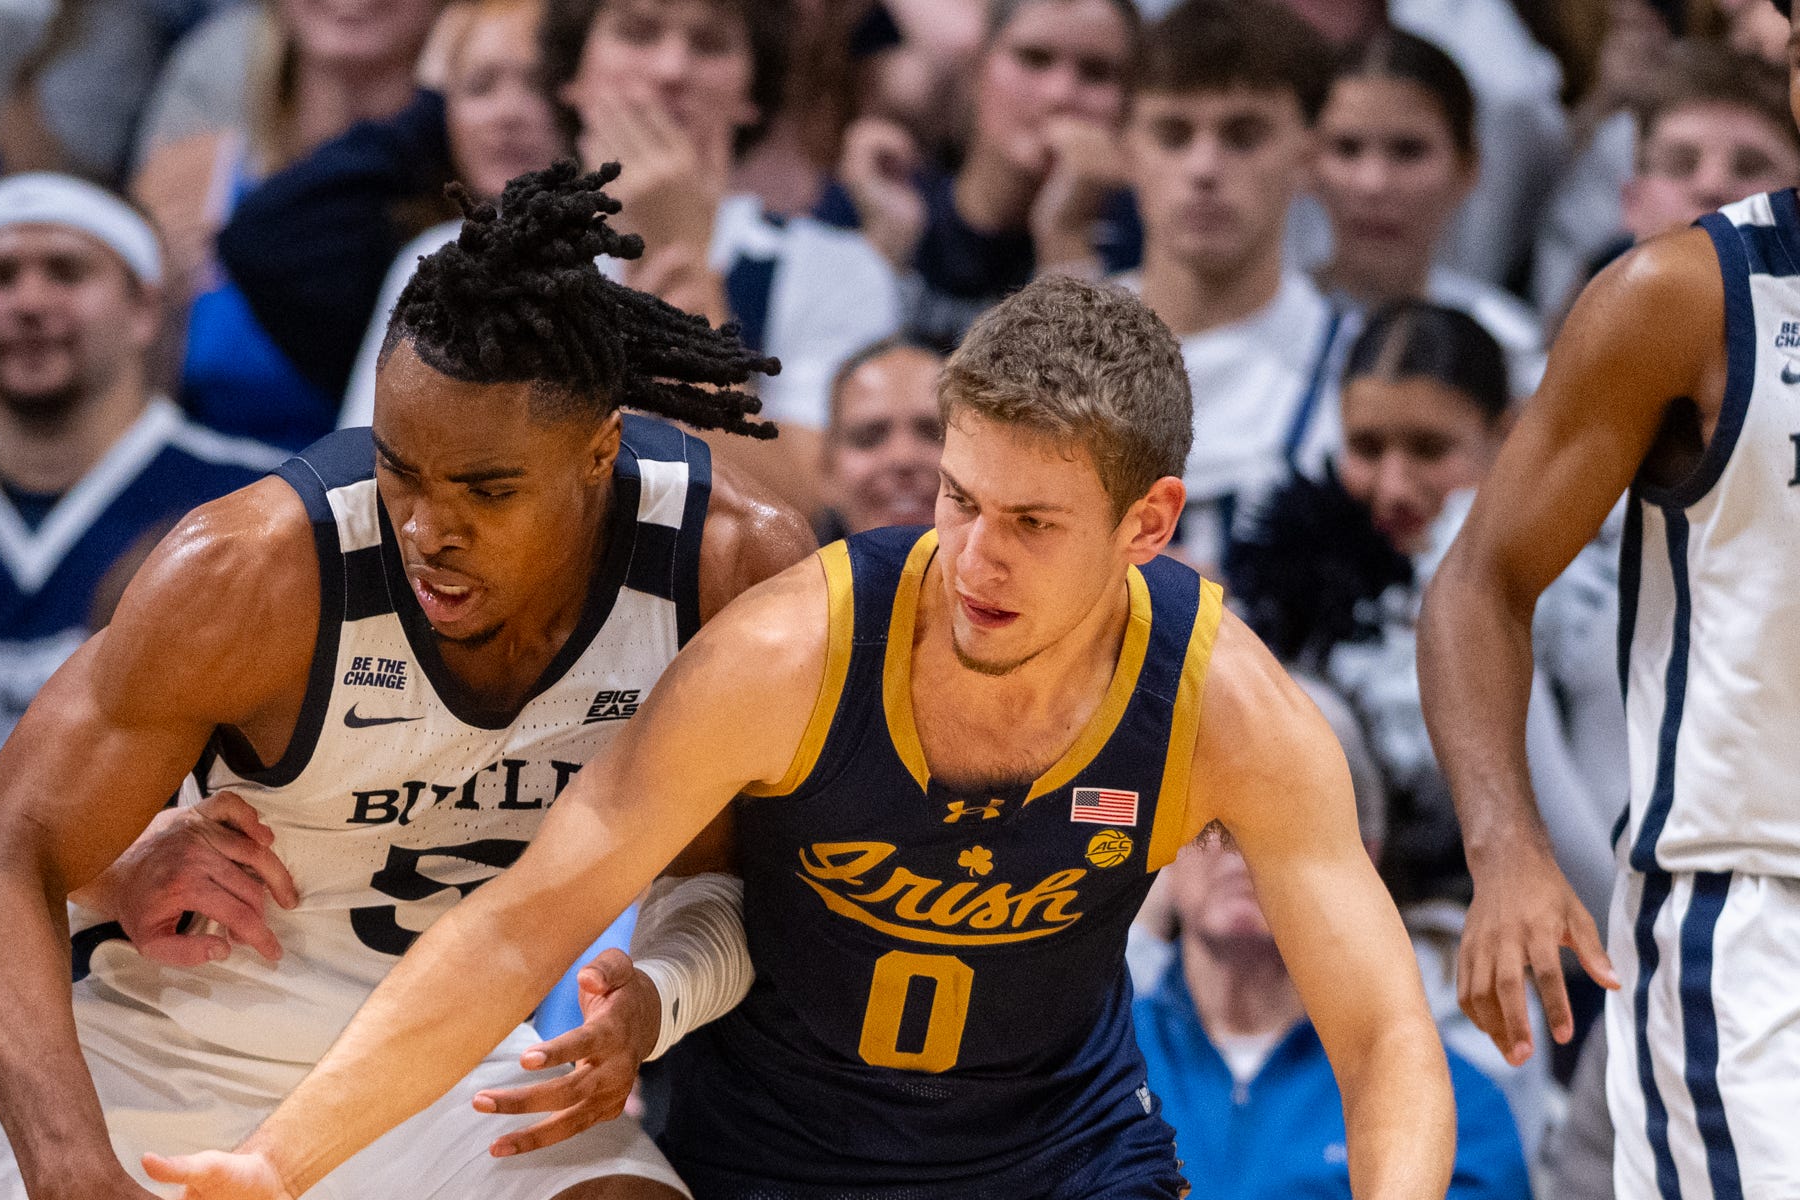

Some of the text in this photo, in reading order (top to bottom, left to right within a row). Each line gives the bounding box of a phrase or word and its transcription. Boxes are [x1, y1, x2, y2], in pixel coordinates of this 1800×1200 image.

[351, 656, 407, 675] BE THE
[343, 671, 407, 691] CHANGE
[593, 689, 641, 704] BIG
[586, 703, 640, 717] EAS
[1090, 840, 1132, 852] ACC
[796, 842, 1088, 938] Irish
[858, 949, 975, 1074] 0
